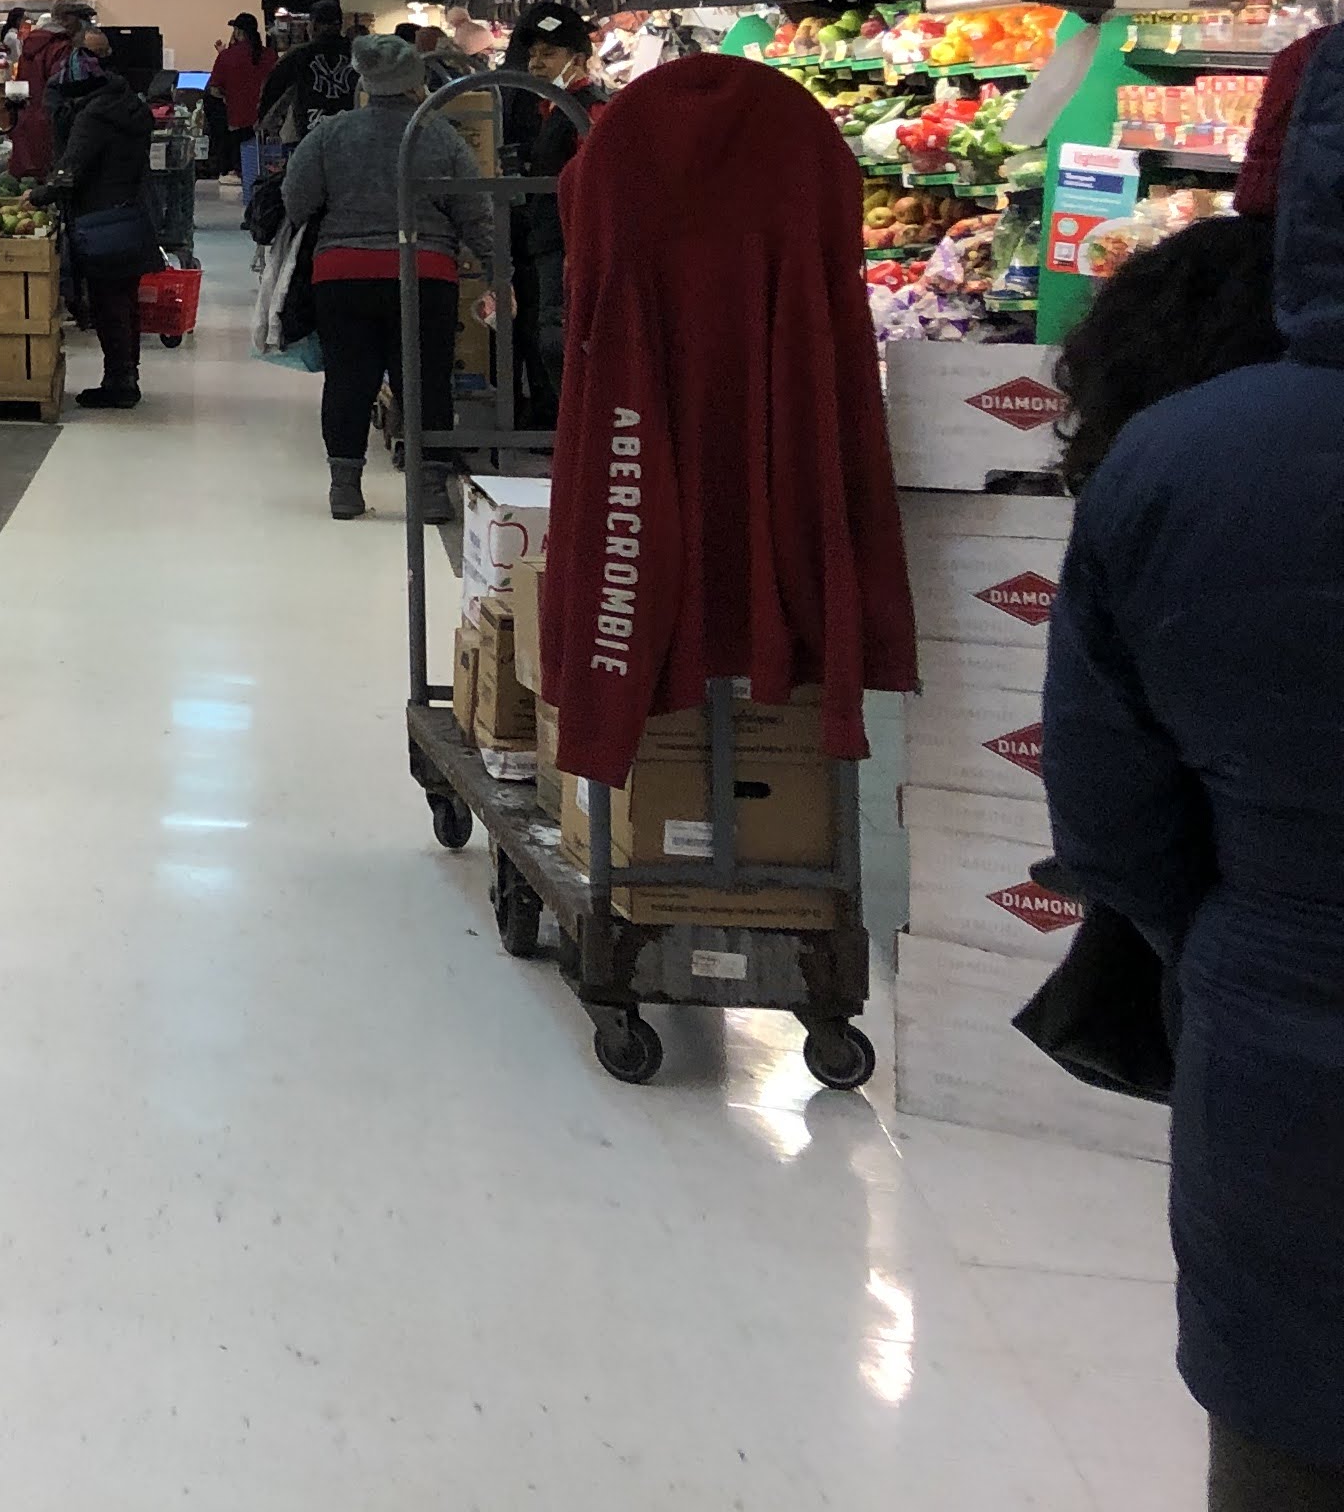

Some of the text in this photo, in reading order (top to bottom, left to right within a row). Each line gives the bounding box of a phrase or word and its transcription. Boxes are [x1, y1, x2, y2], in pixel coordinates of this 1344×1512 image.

[590, 406, 641, 676] ABERCROMBIE
[990, 590, 1055, 606] DIAMO
[998, 740, 1043, 756] DIAM
